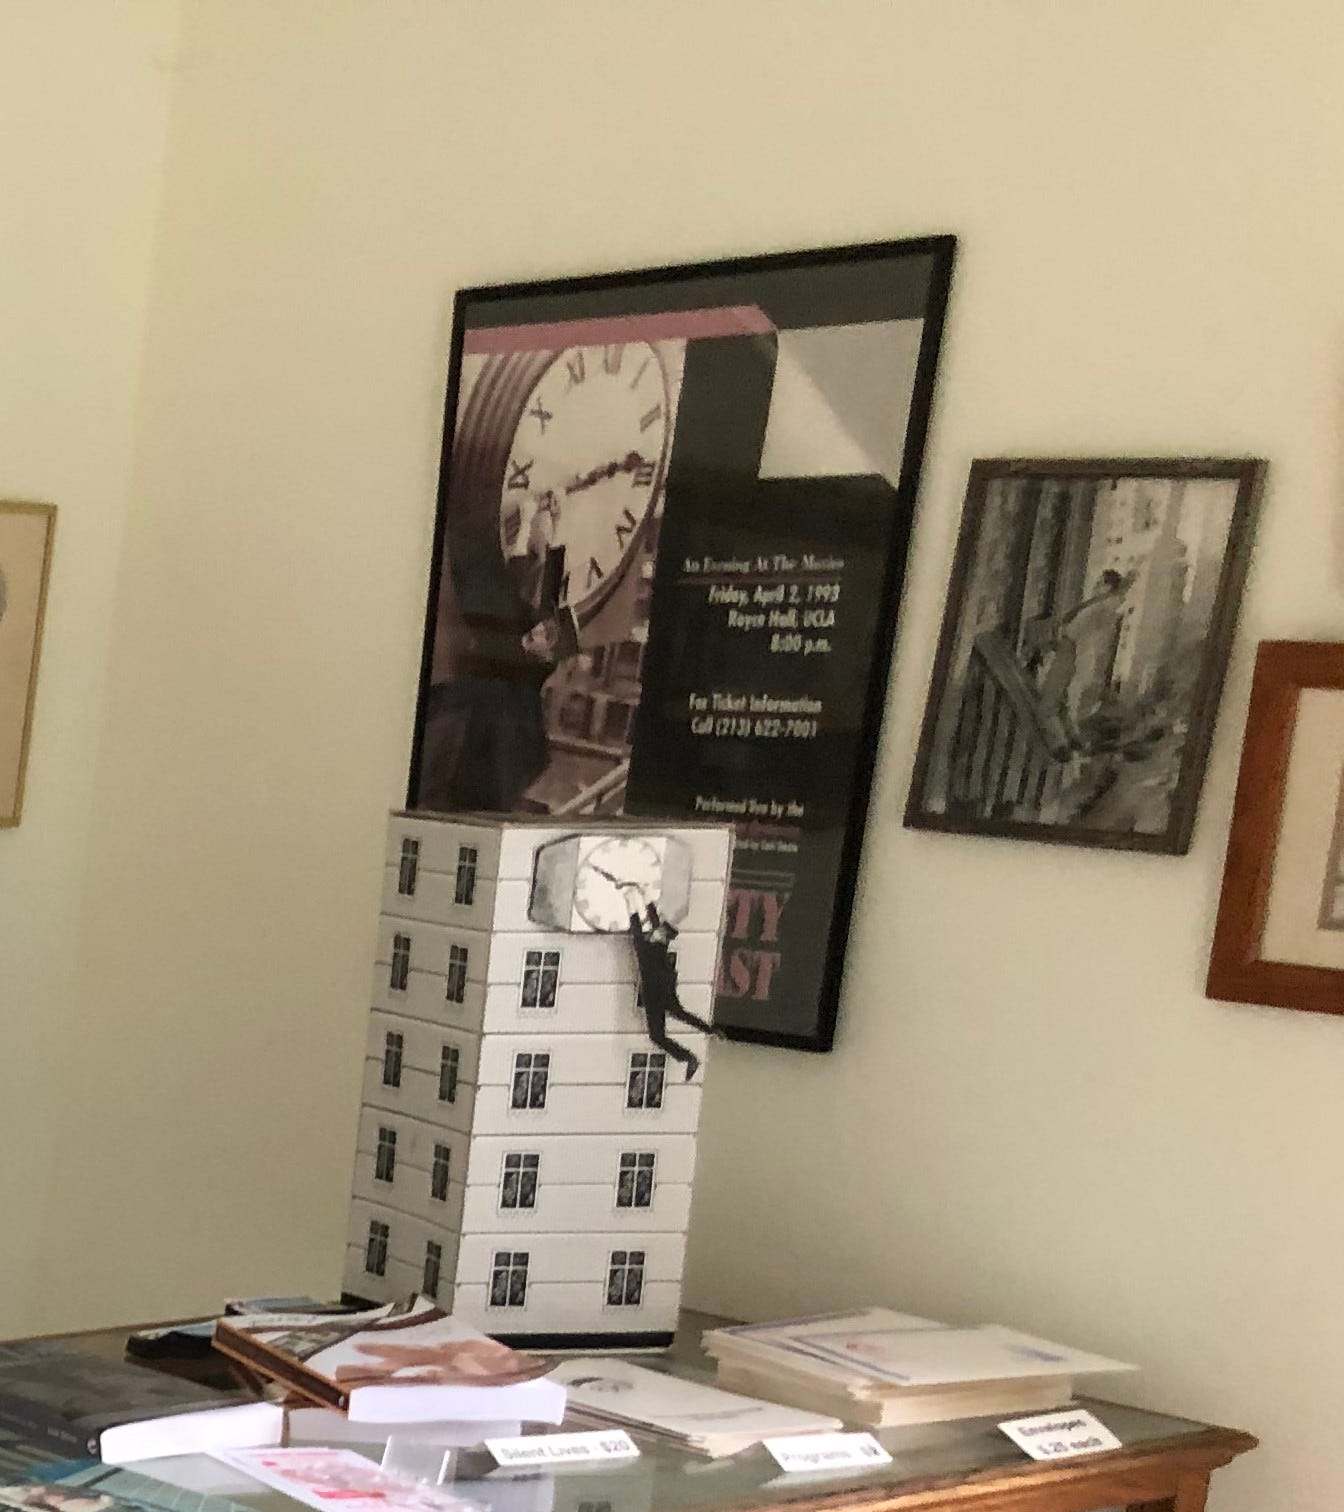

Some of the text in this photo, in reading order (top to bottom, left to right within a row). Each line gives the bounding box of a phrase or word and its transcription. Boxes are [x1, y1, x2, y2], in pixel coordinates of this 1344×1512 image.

[753, 583, 786, 607] April
[803, 609, 835, 628] UCLA
[712, 693, 747, 713] Ticket
[749, 693, 822, 713] Information
[501, 1447, 546, 1460] Silent
